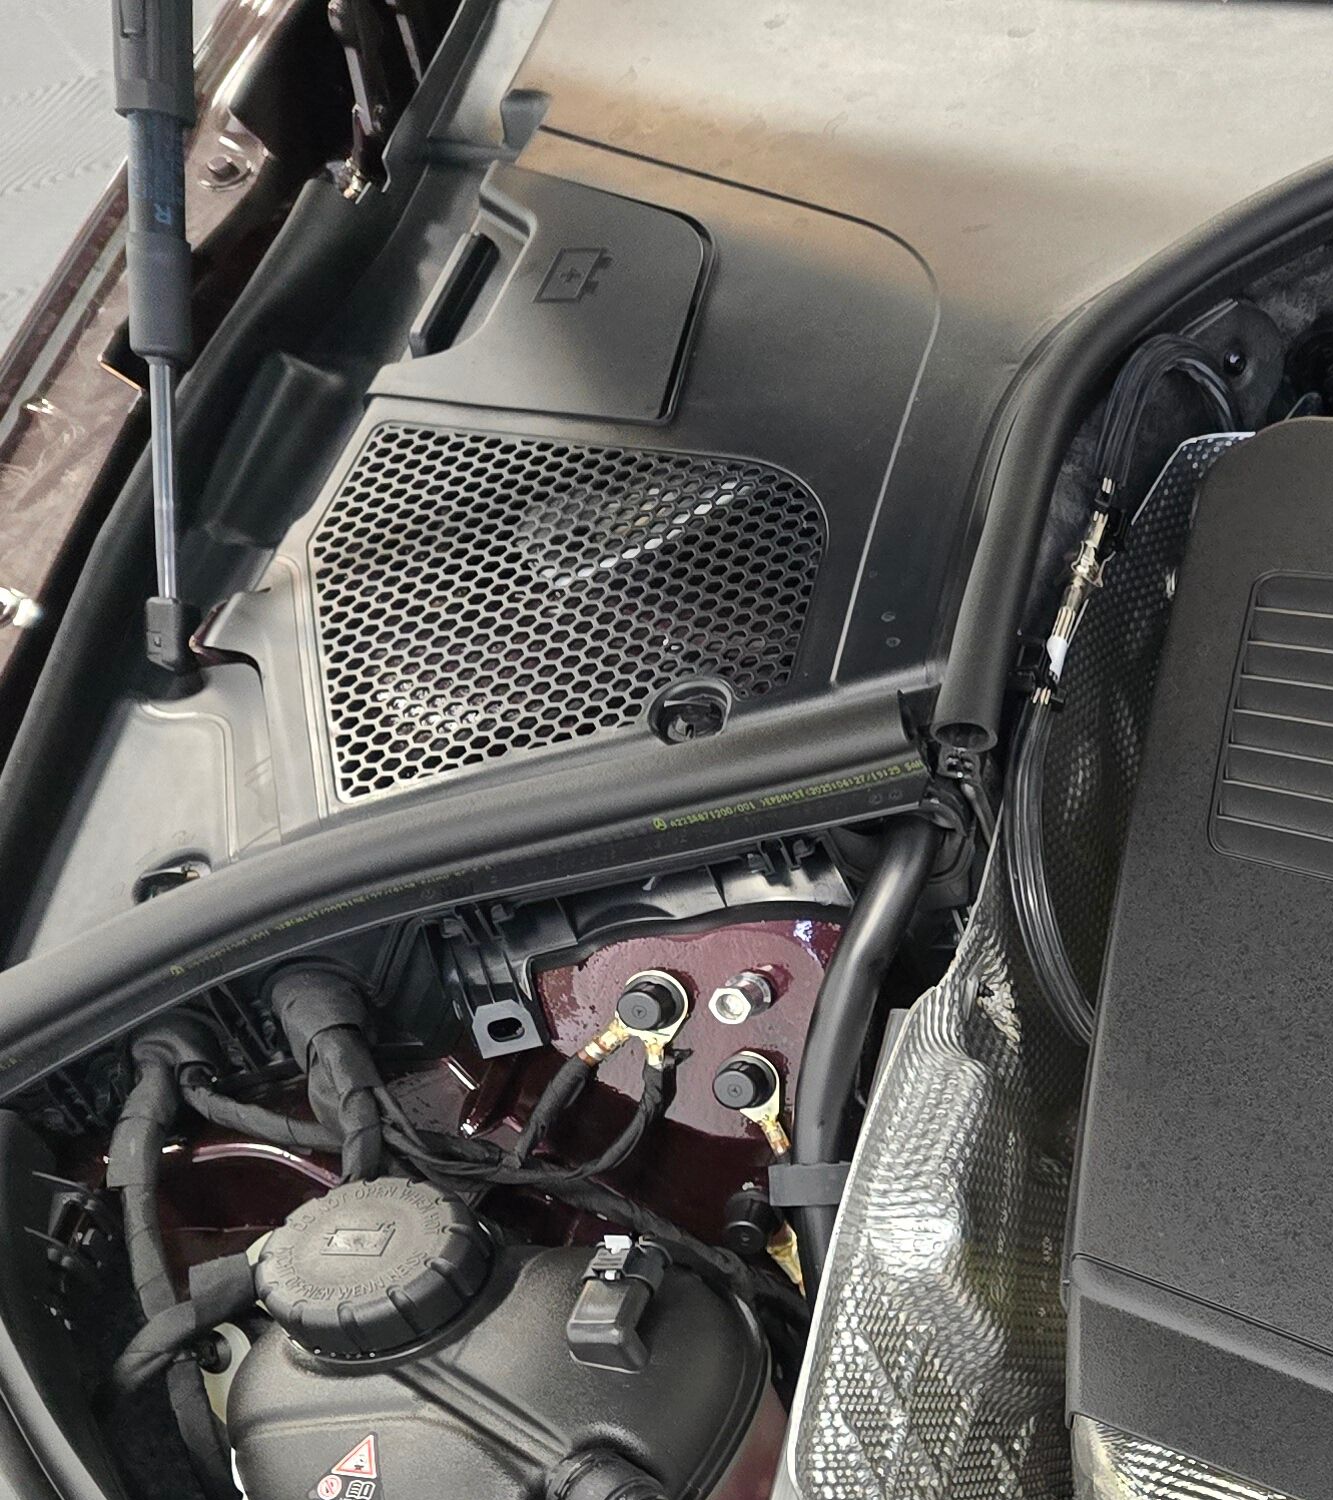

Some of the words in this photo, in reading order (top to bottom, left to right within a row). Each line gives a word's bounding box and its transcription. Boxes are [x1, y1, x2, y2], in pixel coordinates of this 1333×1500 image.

[354, 1185, 398, 1199] OPEN
[400, 1187, 437, 1214] WHEN
[423, 1212, 444, 1237] HOT
[337, 1276, 386, 1301] WENN
